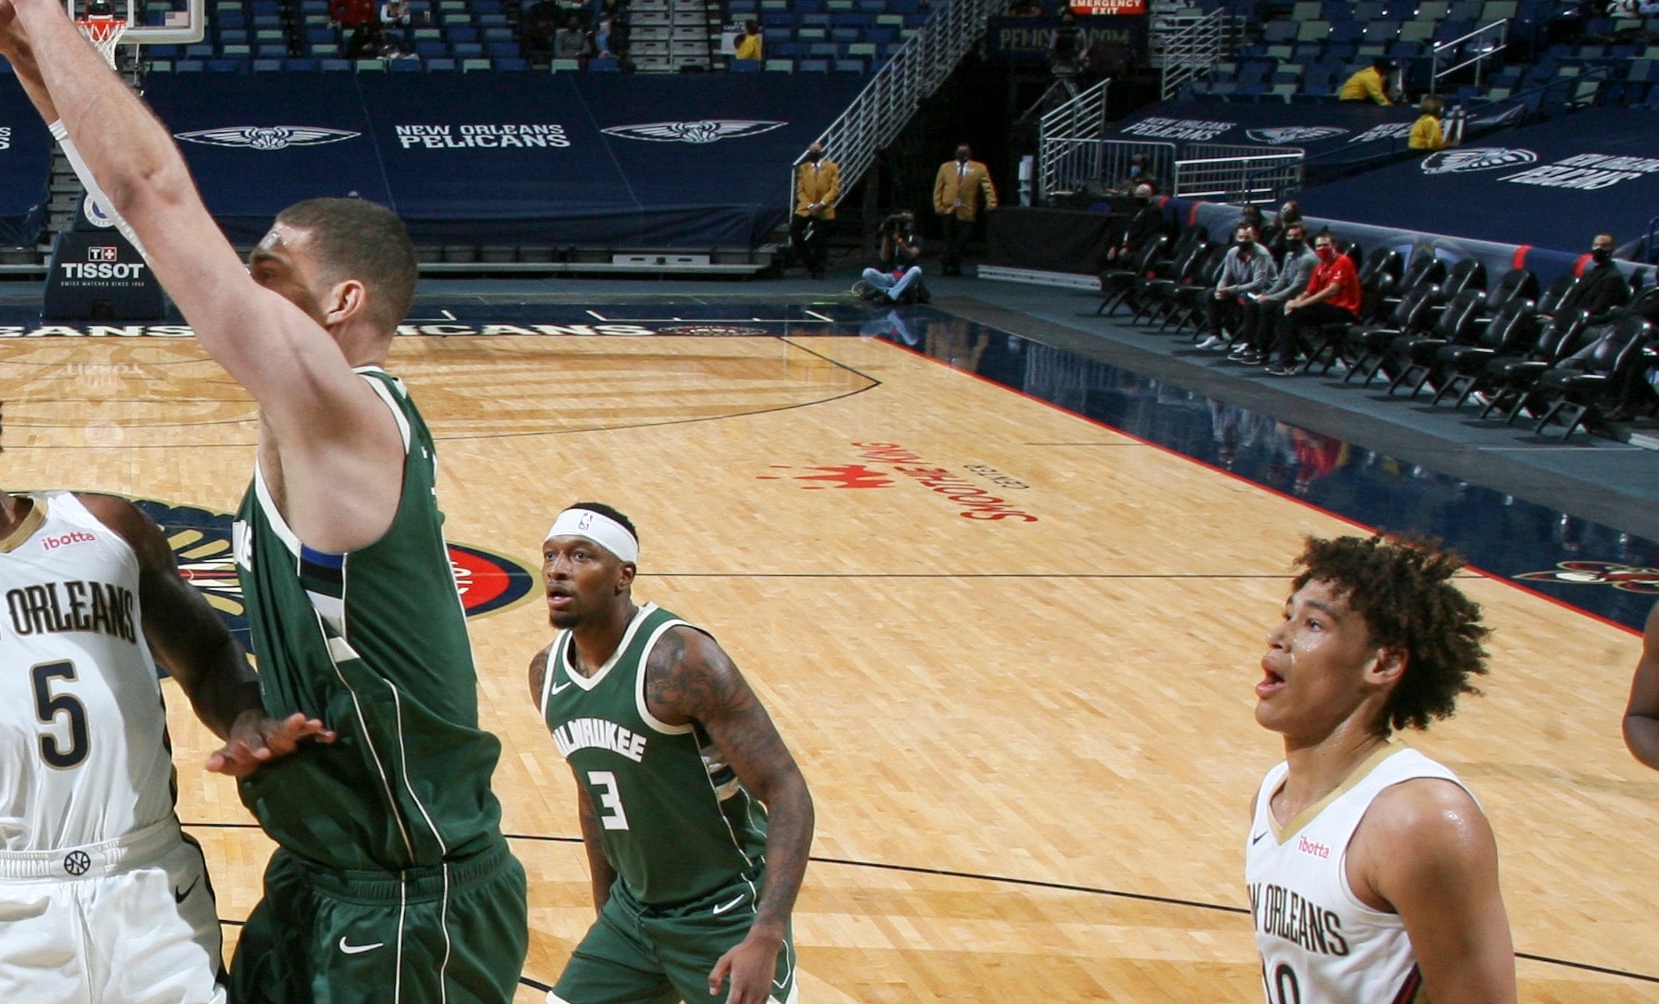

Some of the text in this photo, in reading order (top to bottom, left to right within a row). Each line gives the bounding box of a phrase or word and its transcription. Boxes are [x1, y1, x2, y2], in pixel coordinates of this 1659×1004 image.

[1091, 7, 1119, 15] EXIT
[395, 125, 565, 135] NEW ORLEANS
[398, 135, 571, 148] PELICANS
[61, 263, 144, 278] TISSOT
[394, 323, 656, 336] ICANS
[41, 530, 97, 550] ibotta
[6, 581, 137, 645] ORLEANS
[29, 658, 91, 771] 5
[587, 771, 629, 831] 3
[1298, 835, 1330, 859] ibotta
[1263, 883, 1350, 957] ORLEANS
